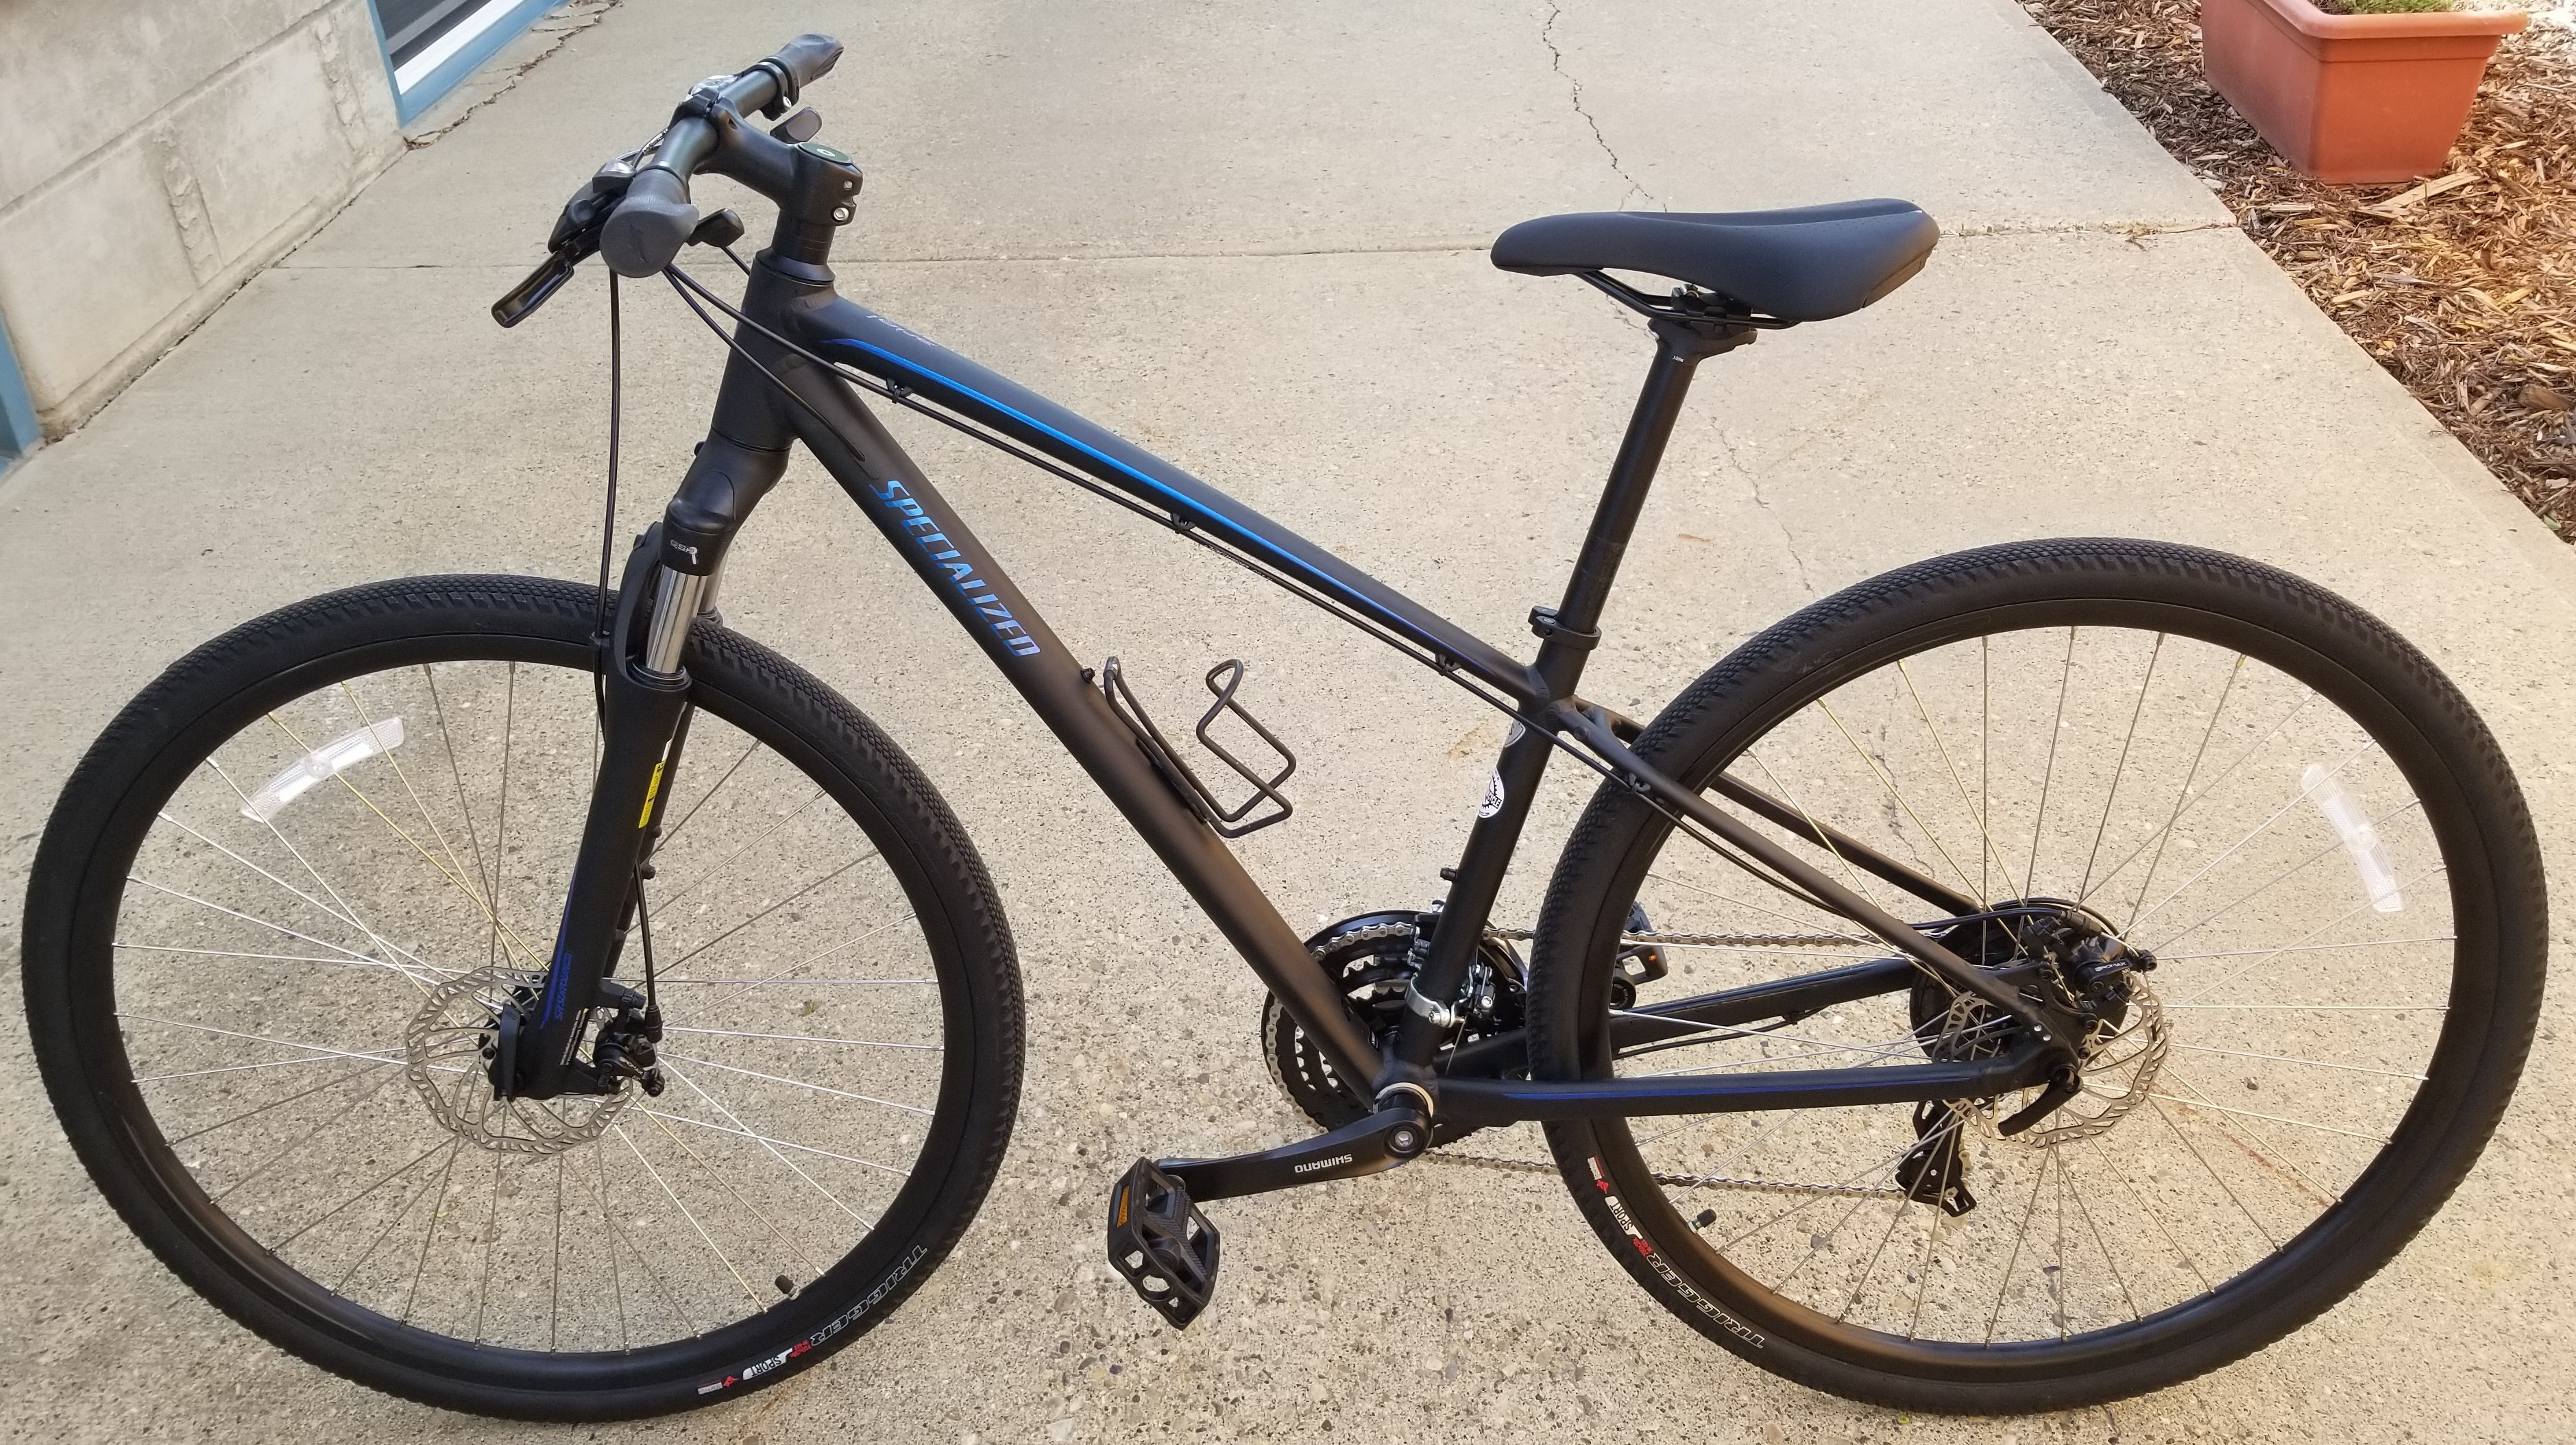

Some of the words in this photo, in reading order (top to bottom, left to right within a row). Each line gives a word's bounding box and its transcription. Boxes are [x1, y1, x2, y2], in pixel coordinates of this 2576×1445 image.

[868, 480, 1041, 657] SPECIALIZED
[1294, 1154, 1352, 1173] SHIMANO
[1609, 1202, 1633, 1231] SPORT
[810, 1244, 927, 1346] TRIGGER
[1646, 1252, 1765, 1349] TRIGGER
[751, 1355, 783, 1377] SPORT
